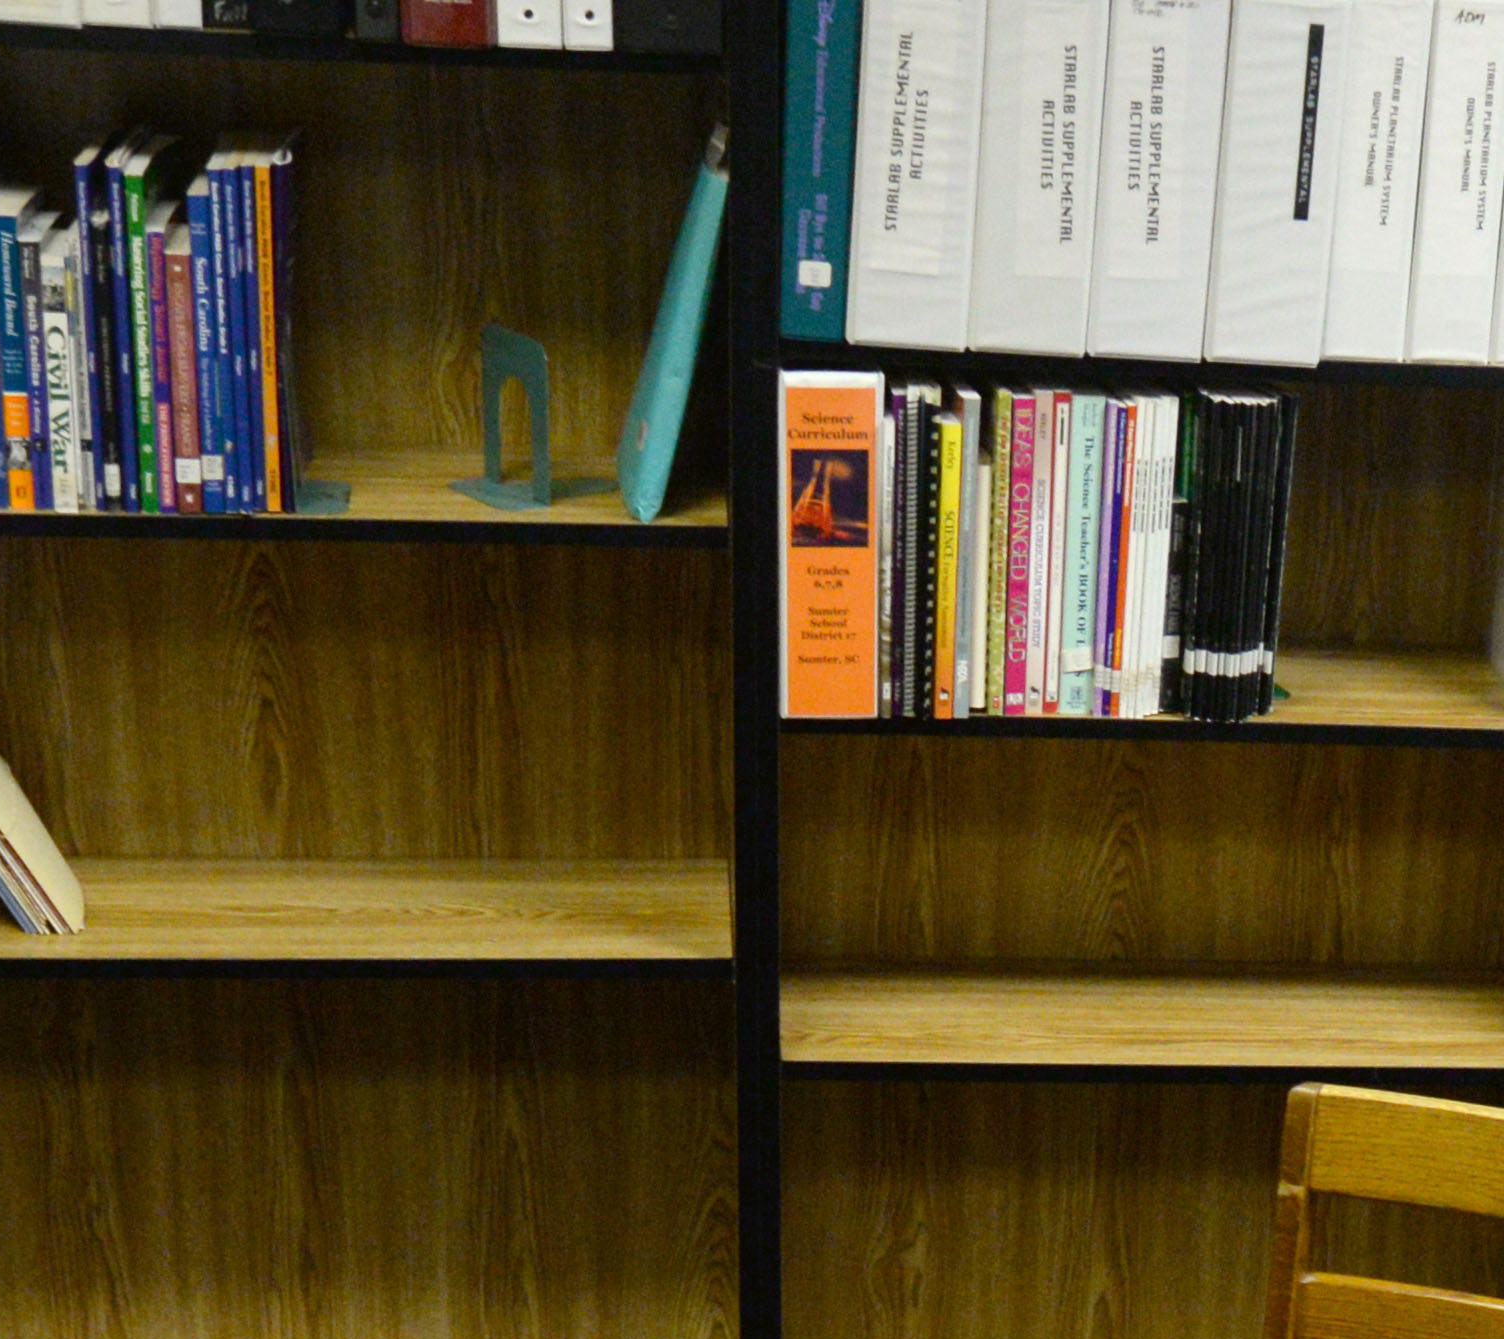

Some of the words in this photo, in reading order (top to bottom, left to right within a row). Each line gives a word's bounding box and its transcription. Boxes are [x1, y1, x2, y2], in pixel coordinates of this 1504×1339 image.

[891, 32, 912, 157] SUPPLEMENTAL
[1063, 45, 1077, 114] STARLAB
[1151, 46, 1165, 115] STARLAB
[1306, 56, 1320, 108] STARLAB
[1392, 57, 1404, 101] STARLAB
[1485, 61, 1496, 107] STARLAB
[909, 89, 929, 180] ACTIVITIES
[1371, 91, 1382, 140] OWNER'S
[1465, 98, 1475, 145] OWNER'S
[1041, 100, 1055, 190] ACTIVITIES
[1128, 101, 1143, 190] ACTIVITIES
[1297, 116, 1313, 204] SUPPLEMENTAL
[1384, 106, 1400, 179] PLANETARIUM
[1480, 111, 1492, 185] PLANETARIUM
[1059, 121, 1076, 244] SUPPLEMENTAL
[1146, 122, 1163, 244] SUPPLEMENTAL
[1365, 144, 1376, 188] MANUAL
[1461, 149, 1472, 193] MANUAL
[884, 163, 903, 231] STARLAB
[1379, 184, 1392, 226] SYSTEM
[1476, 189, 1486, 230] SYSTEM
[0, 229, 16, 294] Homeward
[127, 234, 145, 289] Mastering
[194, 255, 208, 293] South
[3, 296, 18, 335] Bound
[25, 293, 39, 330] South
[134, 289, 147, 325] Social
[196, 297, 211, 350] Carolina
[28, 334, 42, 386] Carolina
[44, 324, 70, 400] Civil
[135, 325, 148, 365] Studies
[49, 409, 71, 473] War
[787, 428, 868, 441] Curriculum
[802, 412, 854, 425] Science
[1013, 408, 1033, 467] IDEAS
[1083, 436, 1095, 457] The
[1035, 479, 1046, 519] SCIENCE
[1080, 462, 1094, 508] Science
[1007, 482, 1031, 580] CHANGED
[1078, 514, 1092, 569] Teacher's
[807, 566, 850, 578] Grades
[1032, 523, 1044, 586] CURRICULUM
[814, 580, 843, 590] 6,7,8
[1031, 587, 1042, 616] TOPIC
[1076, 572, 1088, 611] BOOK
[808, 607, 849, 617] Sumter
[810, 619, 847, 629] School
[1006, 593, 1027, 662] WORLD
[1030, 618, 1041, 648] STUDY
[1075, 615, 1086, 634] OF
[801, 631, 843, 641] District
[798, 655, 841, 666] Sumter,
[844, 655, 860, 664] SC
